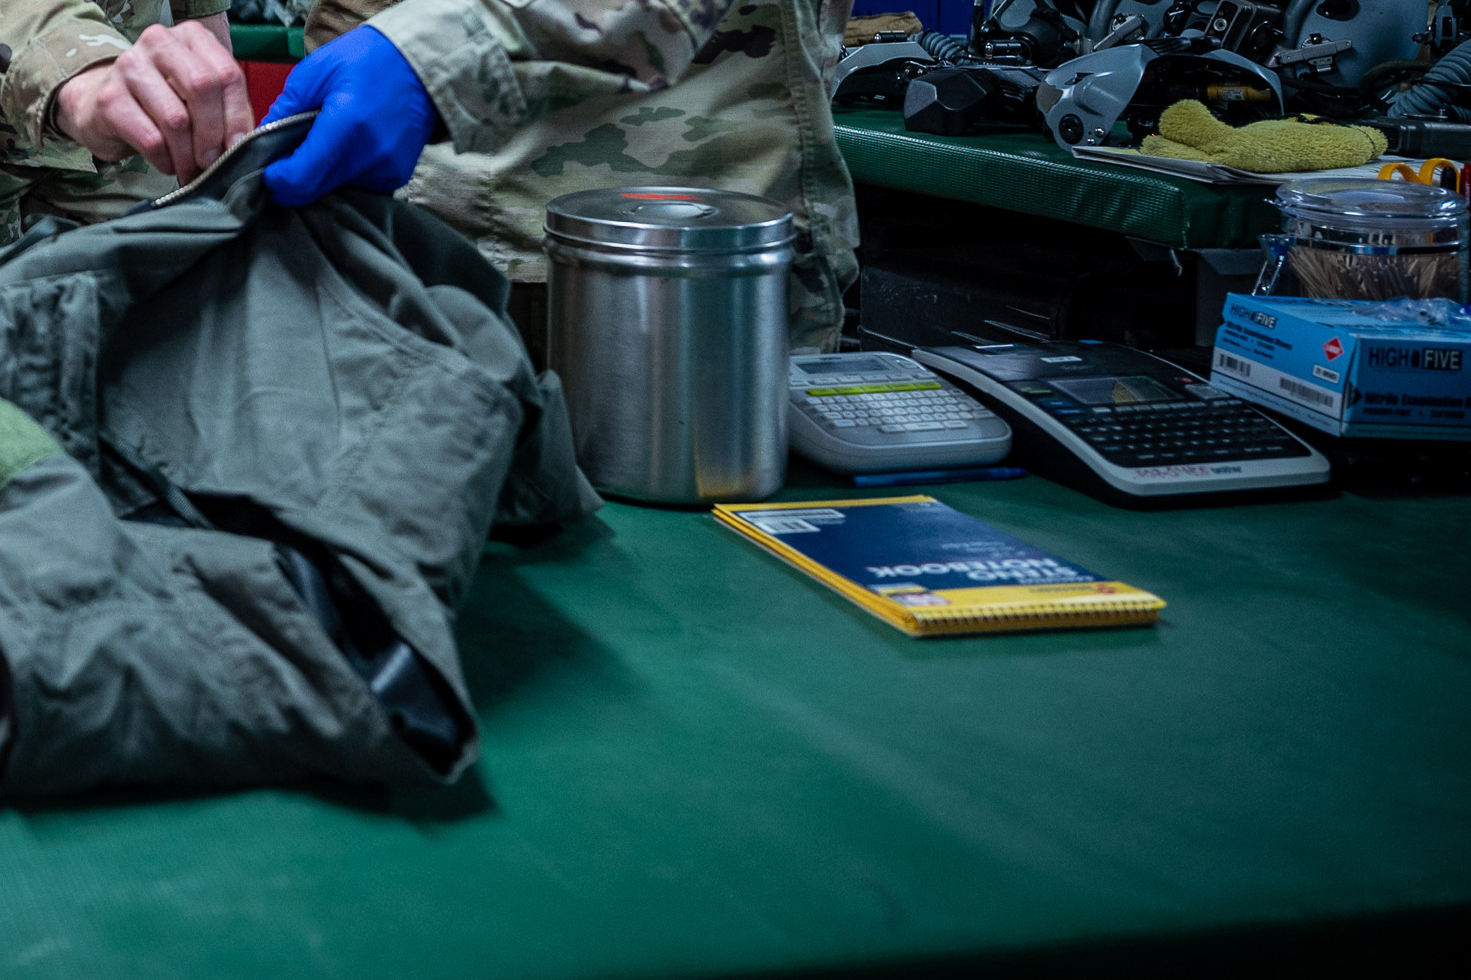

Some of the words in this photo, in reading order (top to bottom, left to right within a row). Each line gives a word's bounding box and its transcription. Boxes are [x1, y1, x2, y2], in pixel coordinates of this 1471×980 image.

[1230, 303, 1251, 321] HIGH
[1255, 311, 1277, 329] FIVE
[1368, 347, 1409, 367] HIGH
[1424, 349, 1461, 370] FIVE
[865, 557, 1059, 578] NOTEBOOK
[966, 566, 1078, 581] STENO
